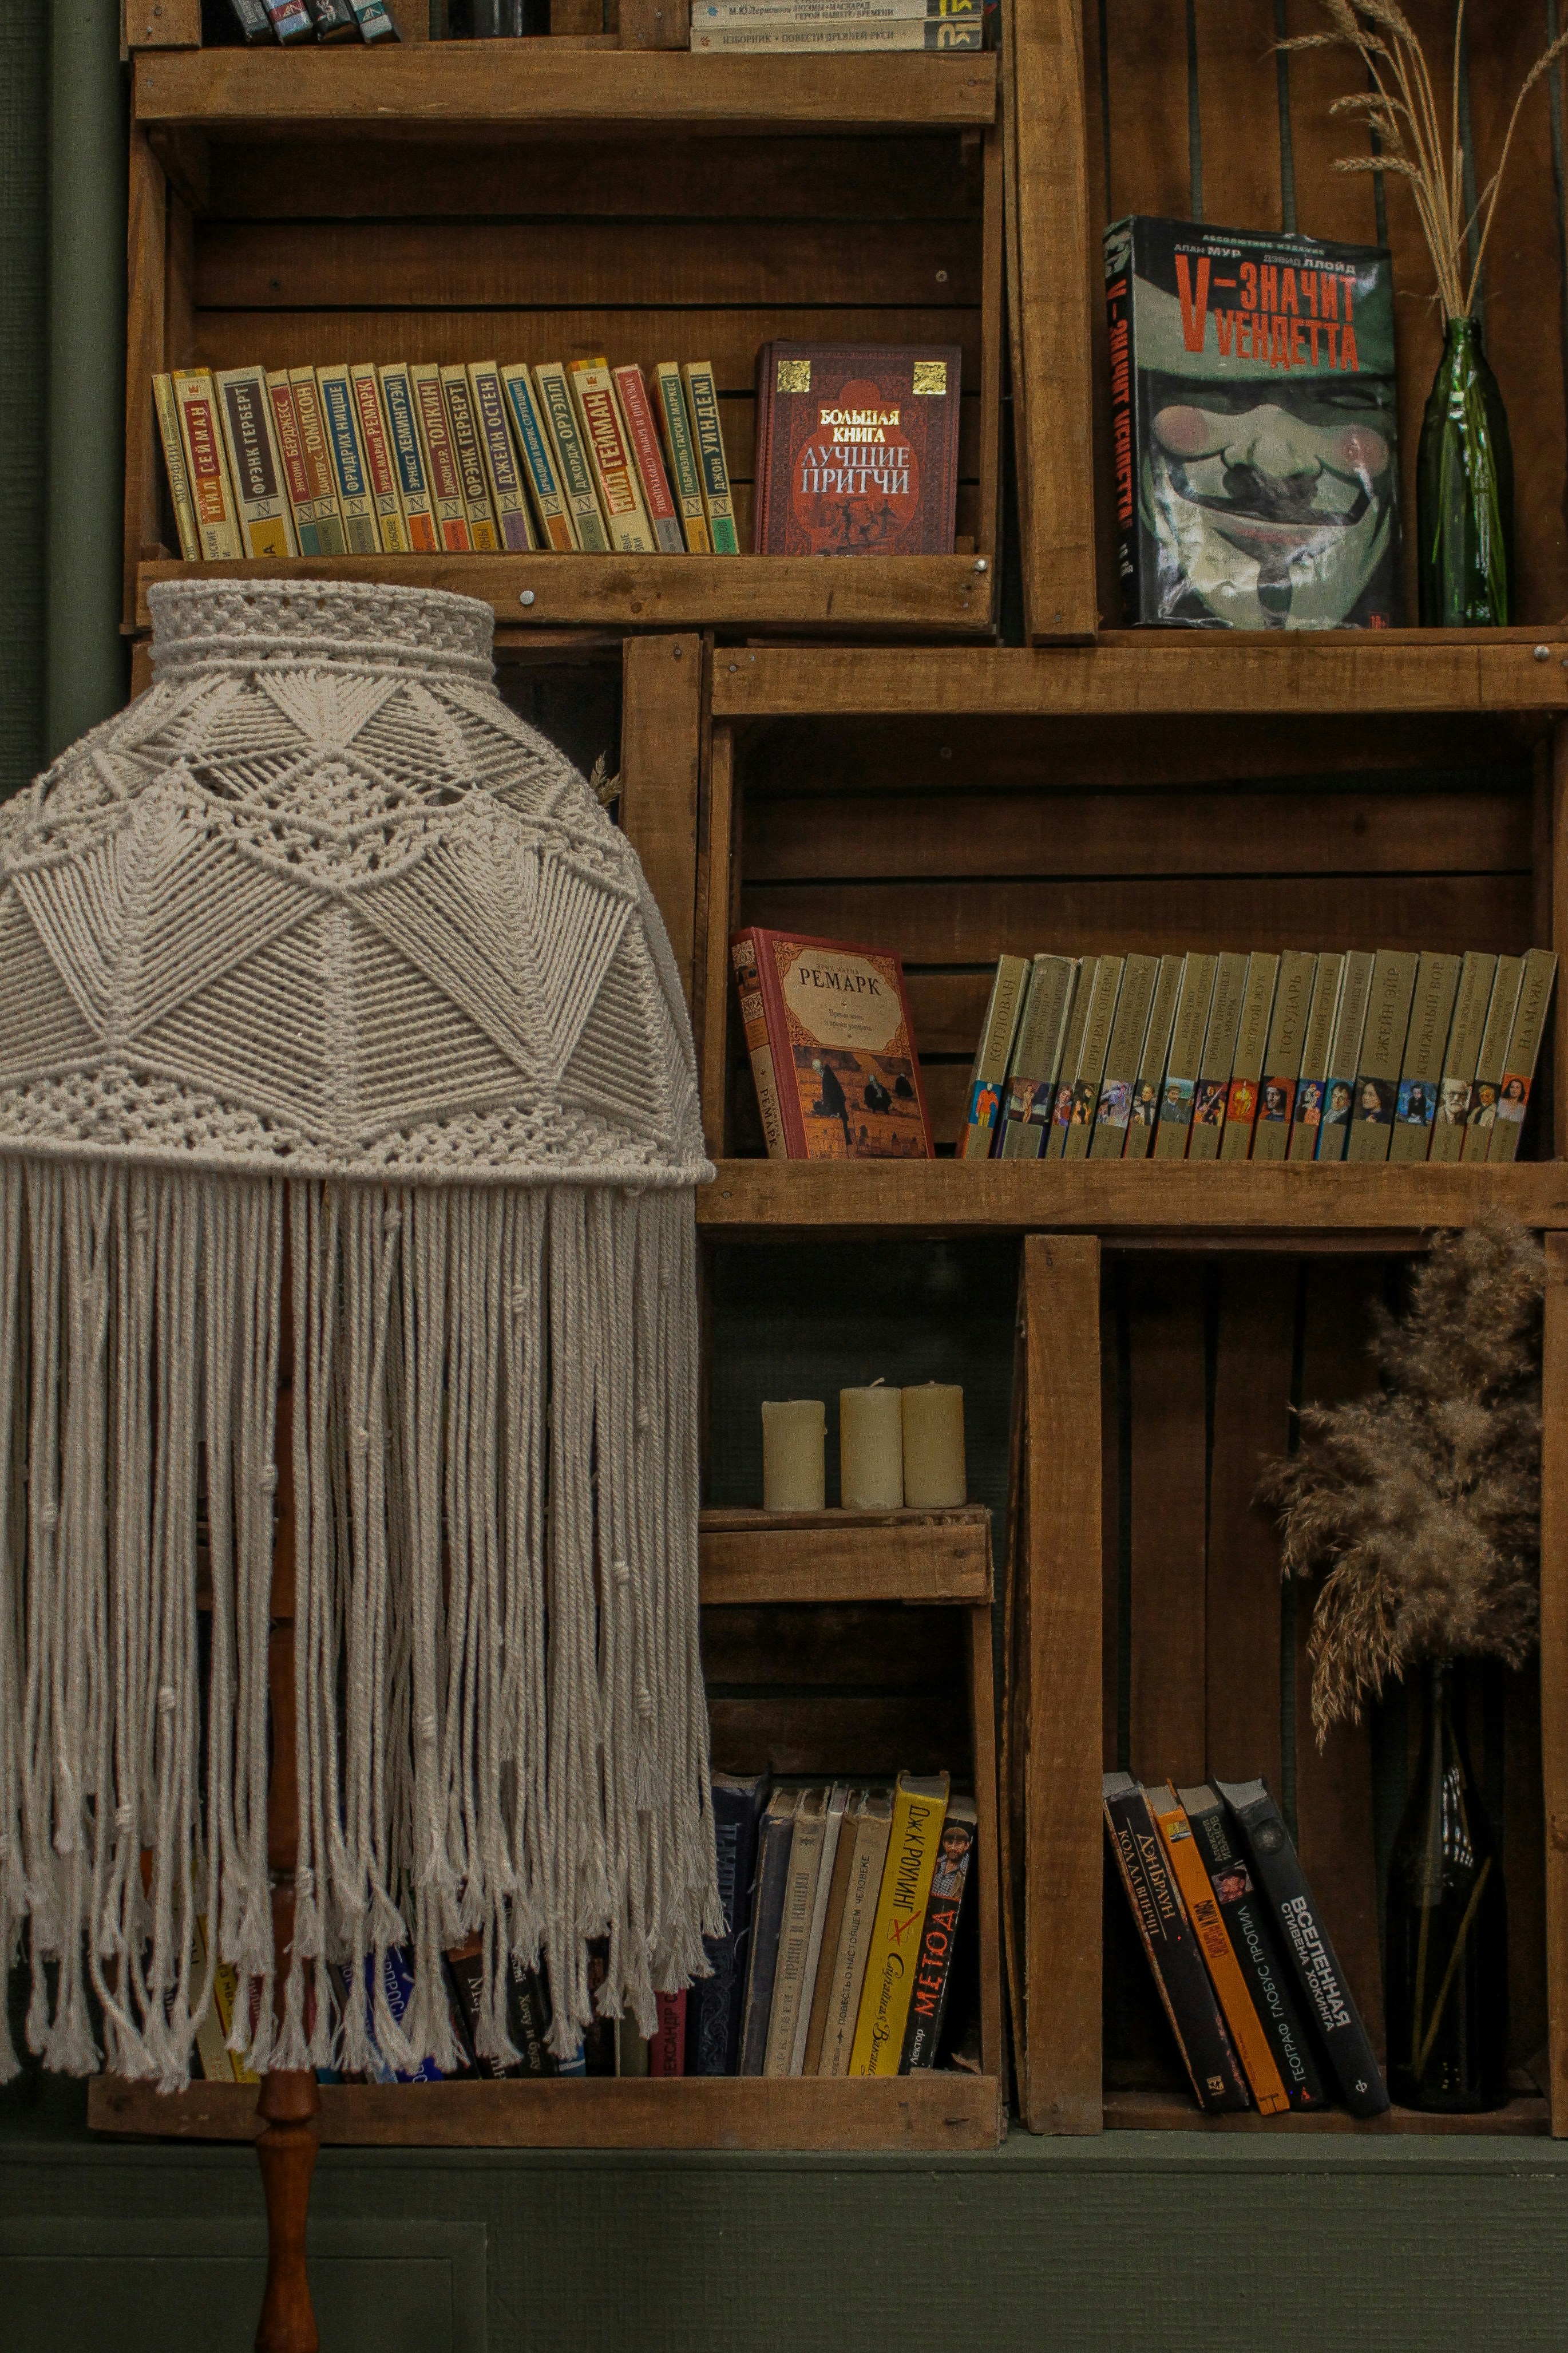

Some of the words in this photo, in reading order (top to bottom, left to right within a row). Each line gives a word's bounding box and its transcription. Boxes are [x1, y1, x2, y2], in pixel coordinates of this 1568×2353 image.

[1174, 243, 1205, 255] АЛАН
[1207, 245, 1242, 259] МУР
[1304, 256, 1356, 276] ЛЛОЙД
[1240, 262, 1357, 323] ЗНАЧИТ
[236, 386, 258, 445] ГЕРБЕРТ
[296, 385, 322, 454] ТОМПСОН
[330, 385, 350, 431] НИЦШЕ
[359, 381, 381, 436] РЕМАРК
[387, 381, 414, 453] ХЕМИНГУЭЙ
[421, 385, 446, 448] ТОЛКИН
[449, 385, 474, 446] ГЕРБЕРТ
[480, 381, 502, 427] ОСТЕН
[513, 382, 532, 427] СТРУГАЦКИЕ
[548, 381, 573, 439] ОРУЭЛЛ
[667, 381, 683, 413] МАРКЕС
[692, 381, 719, 454] УИНДЕМ
[819, 409, 900, 426] БОЛЬШАЯ
[192, 406, 215, 474] ГЕЙМАН
[373, 438, 387, 467] МАРИЯ
[525, 427, 538, 446] БОРИС
[588, 393, 623, 470] ГЕЙМАН
[672, 414, 686, 446] ГАРСИА
[833, 427, 886, 443] КНИГА
[167, 443, 187, 504] МОРФИЙ
[248, 447, 267, 495] ФРЭНК
[290, 460, 306, 493] ЭНТОНИ
[315, 462, 332, 496] ХАНТЕР
[338, 432, 360, 492] ФРИДРИХ
[377, 468, 391, 492] ЭРИХ
[403, 454, 421, 489] ЭРНЕСТ
[442, 462, 457, 495] ДЖОН
[461, 447, 481, 496] ФРЭНК
[490, 430, 516, 485] ДЖЕЙН
[535, 457, 551, 492] АРКАДИЙ
[566, 441, 588, 489] ДЖОРДЖ
[676, 448, 695, 492] ГАБРИЭЛЬ
[711, 457, 727, 489] ДЖОН
[801, 446, 910, 468] ЛУЧШИЕ
[203, 481, 220, 515] НИЛ
[604, 471, 636, 513] НИЛ
[801, 469, 910, 495] ПРИТЧИ
[798, 967, 882, 996] РЕМАРК
[1383, 967, 1399, 998] ЭЙР
[1524, 977, 1543, 1023] МАЯК
[989, 979, 1015, 1063] КОТЛОВАН
[1038, 993, 1051, 1043] ИСТОРИЯ
[1087, 1014, 1105, 1071] ПРИЗРАК
[1098, 966, 1115, 1011] ОПЕРЫ
[1245, 1003, 1261, 1059] ЗОЛОТОЙ
[1257, 974, 1266, 1002] ЖУК
[1280, 974, 1302, 1056] ГОСУДАРЬ
[1310, 1014, 1327, 1069] ВЕЛИКИЙ
[1319, 968, 1334, 1011] ГЭТСБИ
[1341, 1017, 1356, 1069] ЕВГЕНИЙ
[1349, 968, 1364, 1014] ОНЕГИН
[1376, 1003, 1395, 1064] ДЖЕЙН
[1417, 994, 1439, 1075] КНИЖНЫЙ
[1430, 961, 1443, 989] ВОР
[1518, 1029, 1534, 1049] НА
[1209, 1025, 1223, 1065] ДЕВЯТЬ
[760, 1088, 777, 1148] РЕМАРК
[1210, 1815, 1232, 1860] ИВАНОВ
[855, 1854, 870, 1905] ЧЕЛОВЕКЕ
[893, 1846, 923, 1913] РОУЛИНГ
[1118, 1830, 1135, 1863] КОД
[1128, 1865, 1143, 1885] ДА
[1136, 1885, 1159, 1935] ВИНЧИ
[1149, 1868, 1175, 1920] БРАУН
[790, 1923, 803, 1933] И
[846, 1909, 861, 1970] НАСТОЯЩЕМ
[1237, 1905, 1266, 1963] ПРОПИЛ
[785, 1938, 802, 1980] ПРИНЦ
[845, 1971, 853, 1979] О
[913, 1909, 956, 2018] МЕТОД
[1280, 1902, 1311, 1966] СТИВЕНА
[1304, 1969, 1336, 2032] ХОКИНГА
[1290, 1895, 1352, 2028] ВСЕЛЕННАЯ
[520, 1992, 533, 2026] Хочу
[838, 1981, 852, 2025] ПОВЕСТЬ
[875, 1952, 904, 2022] Случайная
[1257, 1964, 1285, 2019] ГЛОБУС
[525, 2030, 534, 2039] и
[781, 1994, 794, 2033] ТВЕН
[528, 2041, 542, 2070] буду
[909, 2028, 926, 2065] Лектор
[1278, 2023, 1306, 2082] ГЕОГРАФ
